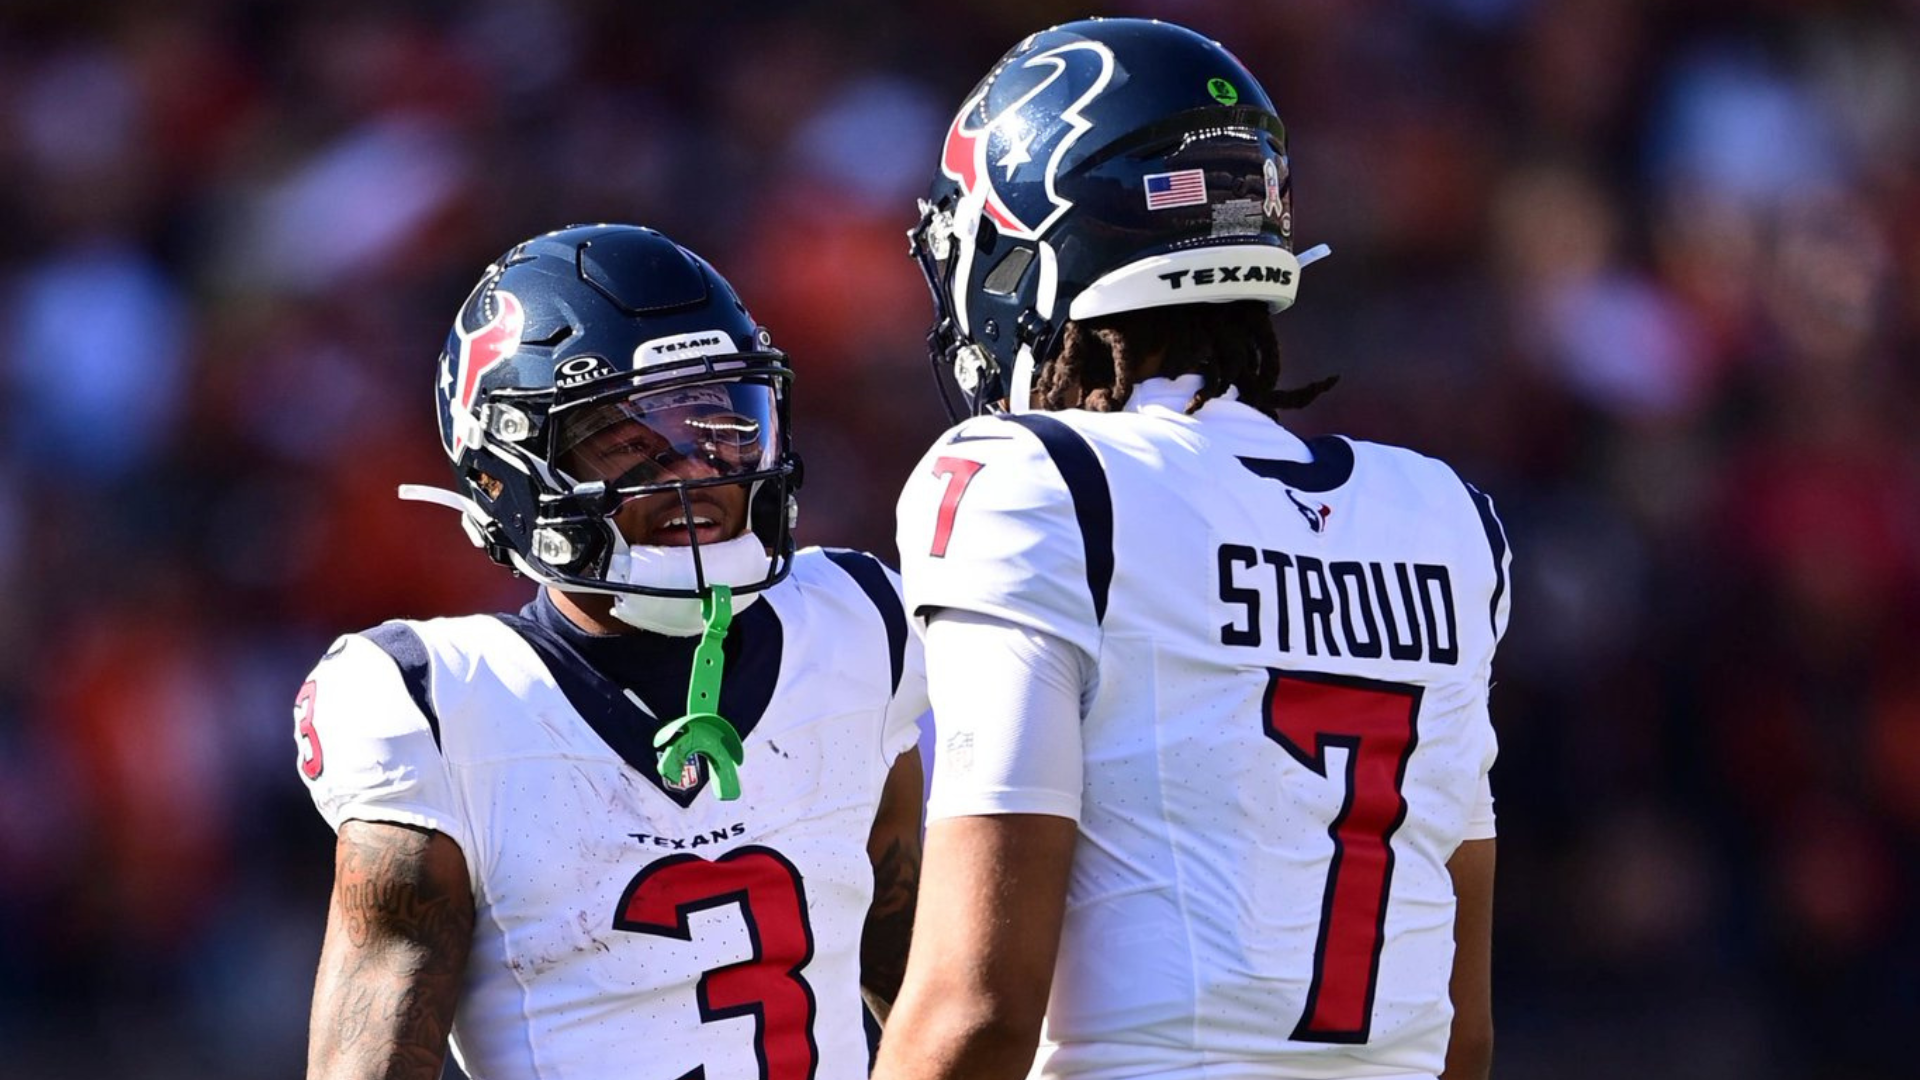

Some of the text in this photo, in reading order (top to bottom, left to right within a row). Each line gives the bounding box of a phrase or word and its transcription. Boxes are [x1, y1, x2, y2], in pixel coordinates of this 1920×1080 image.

[1158, 266, 1292, 289] TEXANS
[557, 367, 609, 387] OAKLEY
[652, 337, 721, 354] TEXANS
[930, 455, 985, 558] 7
[1218, 543, 1459, 666] STROUD
[294, 679, 324, 781] 3
[627, 822, 746, 850] TEXANS
[1261, 667, 1424, 1044] 7
[612, 845, 819, 1080] 3
